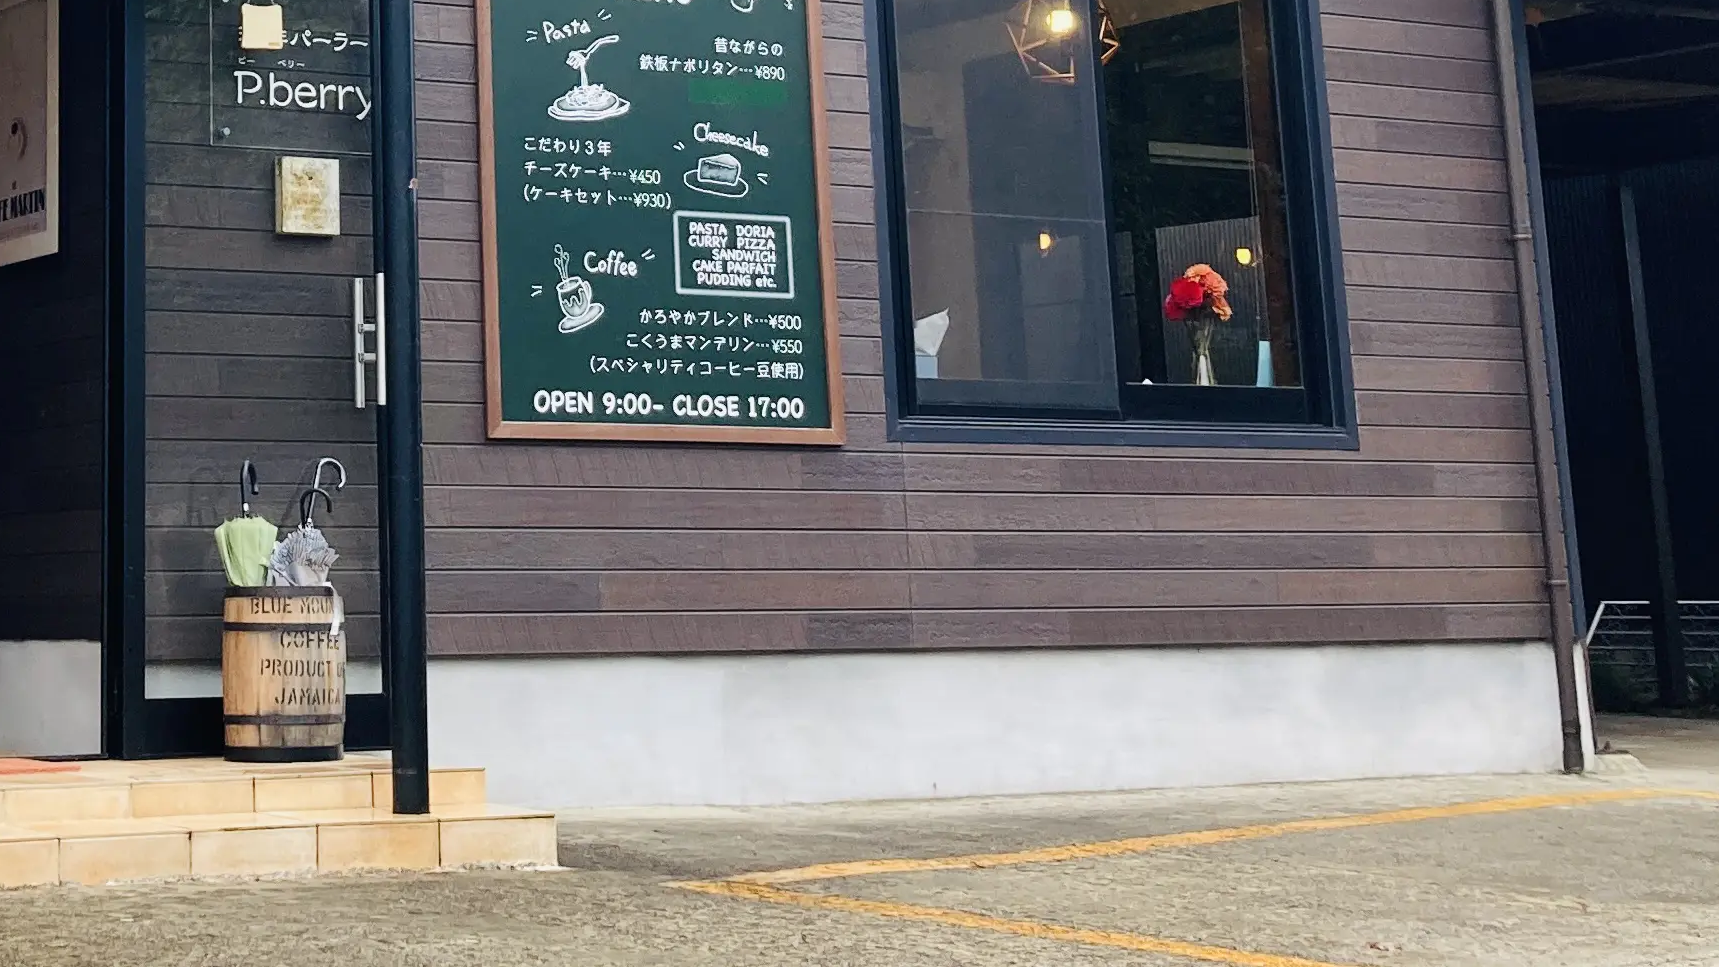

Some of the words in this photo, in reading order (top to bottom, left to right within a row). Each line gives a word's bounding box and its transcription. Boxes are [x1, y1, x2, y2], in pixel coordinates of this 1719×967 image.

[239, 26, 369, 52] パーラー
[542, 19, 591, 43] Pasta
[714, 37, 783, 57] 昔ながらの
[234, 70, 372, 121] P.berry
[524, 136, 612, 157] こだわり3年
[693, 122, 769, 157] Cheesecake
[688, 221, 728, 236] PASTA
[735, 224, 775, 239] DORIA
[688, 234, 729, 249] CURRY
[736, 237, 776, 251] PIZZA
[583, 251, 638, 277] Coffee
[711, 248, 777, 263] SANDWICH
[692, 259, 723, 273] CAKE
[726, 260, 777, 276] PARFAIT
[697, 272, 752, 288] PUDDING
[755, 274, 777, 288] etc.
[533, 389, 594, 415] OPEN
[672, 393, 740, 417] CLOSE
[747, 396, 805, 419] 17:00
[250, 596, 293, 614] BLUE
[280, 631, 340, 650] COFFEE
[260, 658, 332, 677] PRODUCT
[274, 687, 342, 706] JAMAICA
